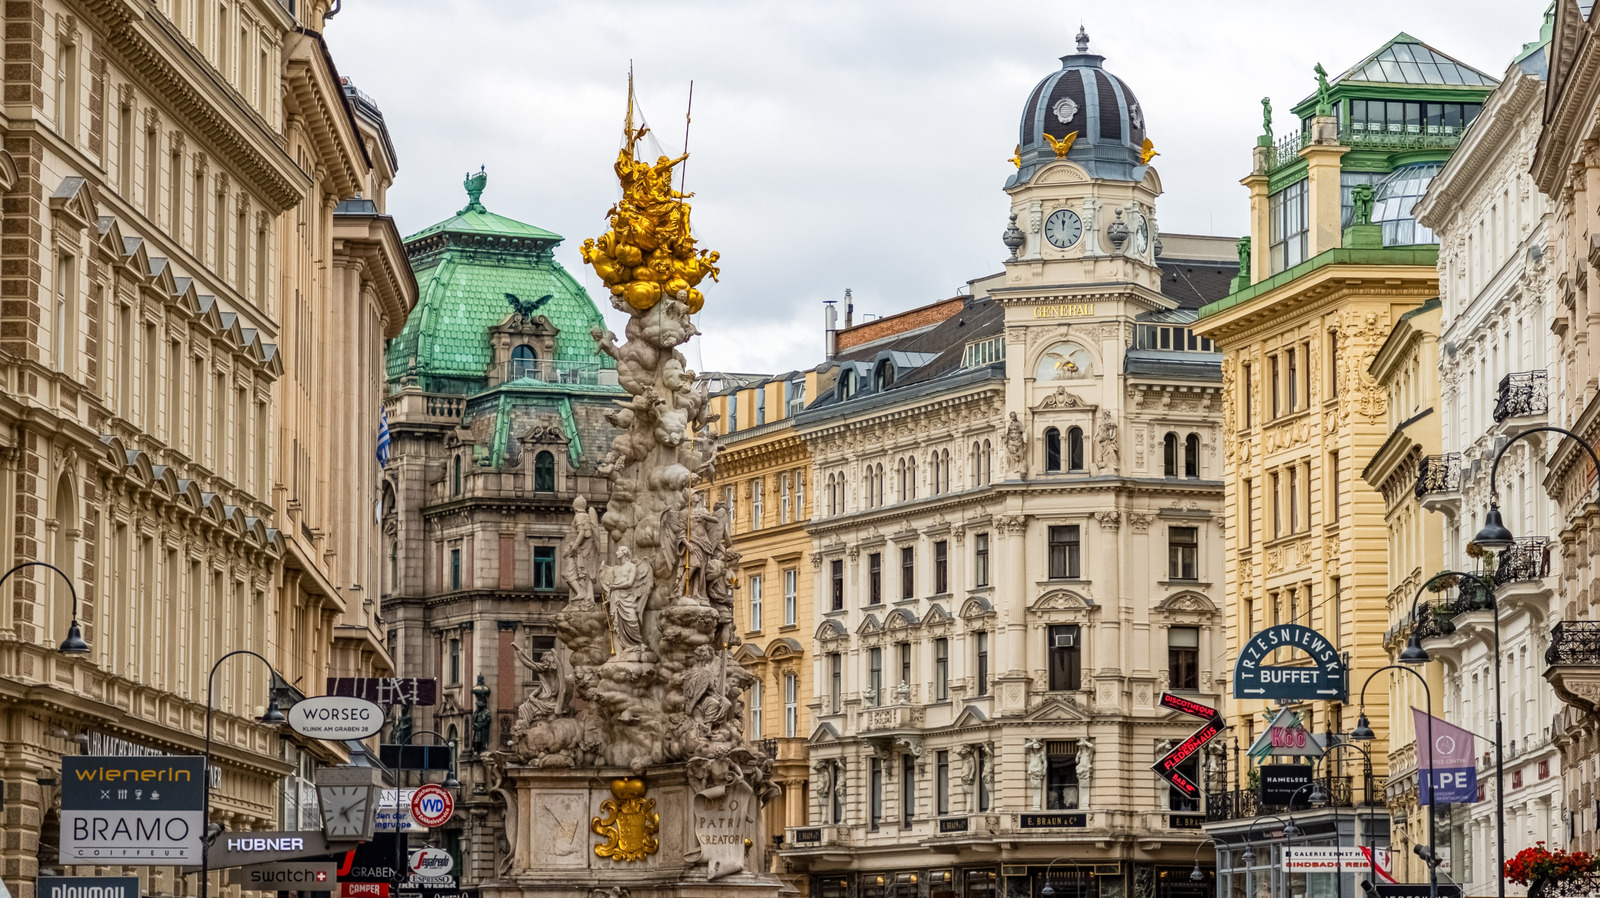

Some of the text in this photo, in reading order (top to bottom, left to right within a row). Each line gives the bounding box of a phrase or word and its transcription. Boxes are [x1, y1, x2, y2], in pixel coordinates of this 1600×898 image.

[1033, 303, 1095, 318] GENERALI
[1260, 670, 1320, 683] BUFFET
[1164, 695, 1215, 716] DISCOTHEQUE
[302, 708, 370, 721] WORSEG
[1163, 726, 1217, 770] FLEDERMAUS
[1172, 773, 1187, 786] BAR
[422, 798, 444, 813] VVD
[703, 798, 739, 811] DEO
[699, 816, 742, 829] PATRI
[1036, 816, 1062, 826] BRAUN
[73, 817, 189, 841] BRAMO
[227, 837, 304, 851] HÜBNER
[699, 834, 744, 845] CREATORI
[413, 851, 450, 870] Segafredo
[251, 868, 315, 882] swatch
[351, 866, 397, 878] GRABEN
[348, 884, 380, 896] CAMPER
